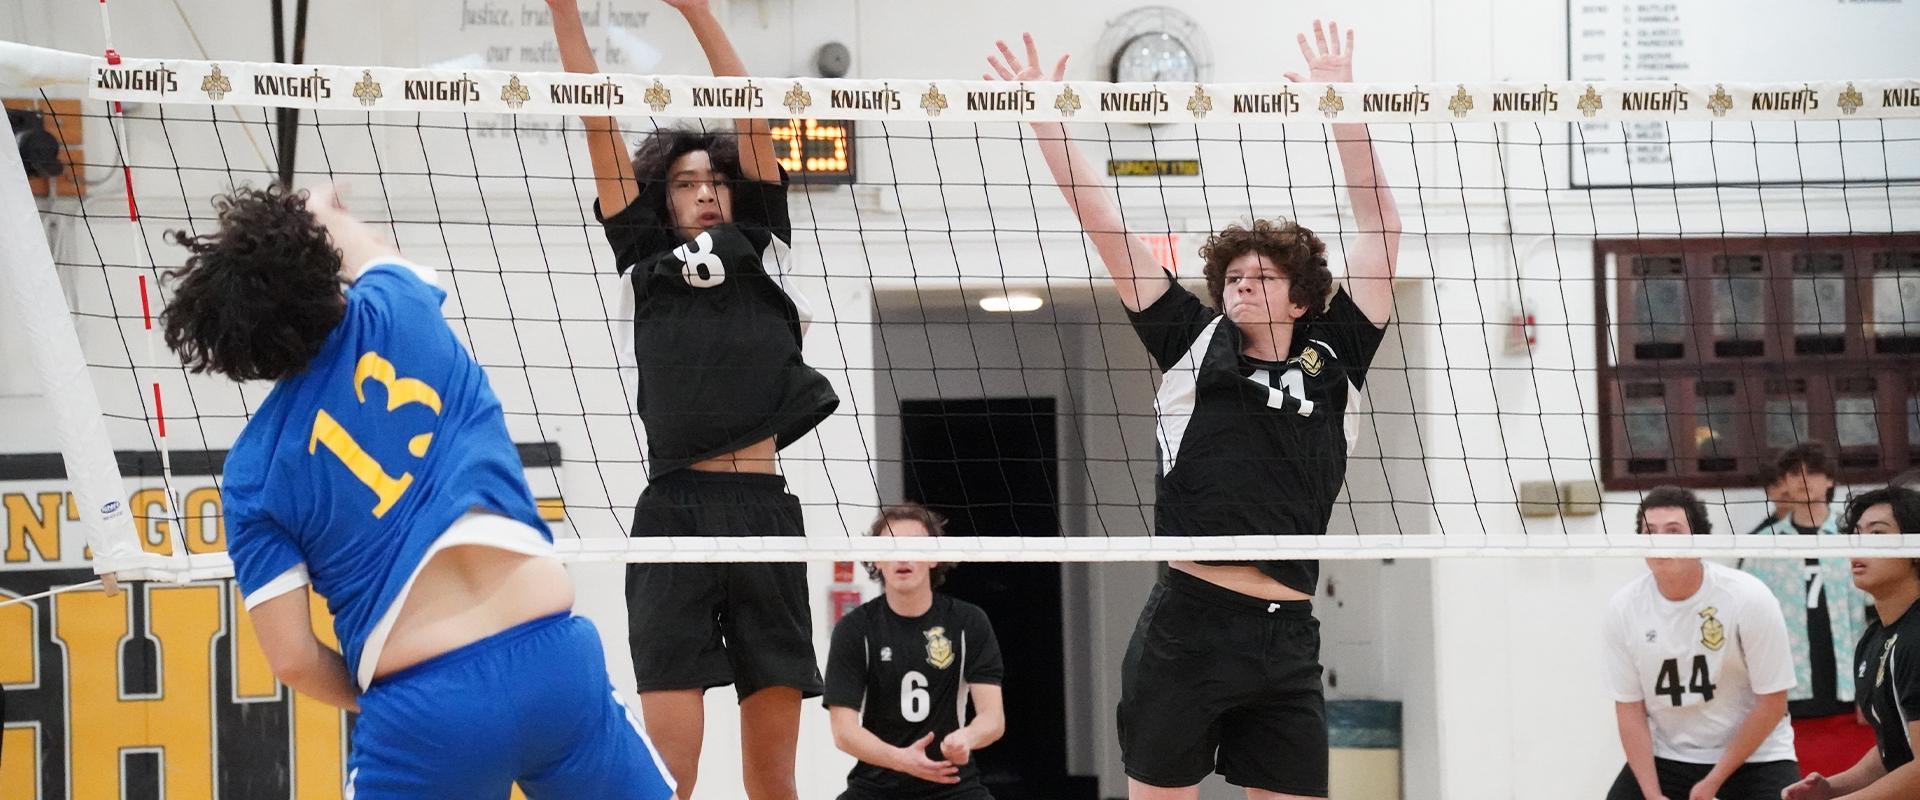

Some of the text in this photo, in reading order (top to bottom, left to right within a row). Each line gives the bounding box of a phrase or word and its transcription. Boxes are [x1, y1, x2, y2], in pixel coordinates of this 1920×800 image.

[97, 62, 178, 97] KNIGHTS
[254, 68, 332, 103] KNIGHTS
[404, 72, 481, 106] KNIGHTS
[550, 76, 624, 109] KNIGHTS
[692, 79, 764, 113] KNIGHTS
[830, 82, 901, 115] KNIGHTS
[967, 83, 1035, 115] KNIGHTS
[1100, 84, 1169, 116] KNIGHTS
[1233, 85, 1299, 116] KNIGHTS
[1363, 84, 1430, 116] KNIGHTS
[1492, 84, 1558, 115] KNIGHTS
[1621, 83, 1689, 115] KNIGHTS
[1751, 83, 1819, 115] KNIGHTS
[673, 231, 726, 288] 8
[308, 351, 442, 519] 13
[1804, 565, 1824, 609] 7
[901, 670, 931, 723] 6
[1655, 654, 1717, 707] 44
